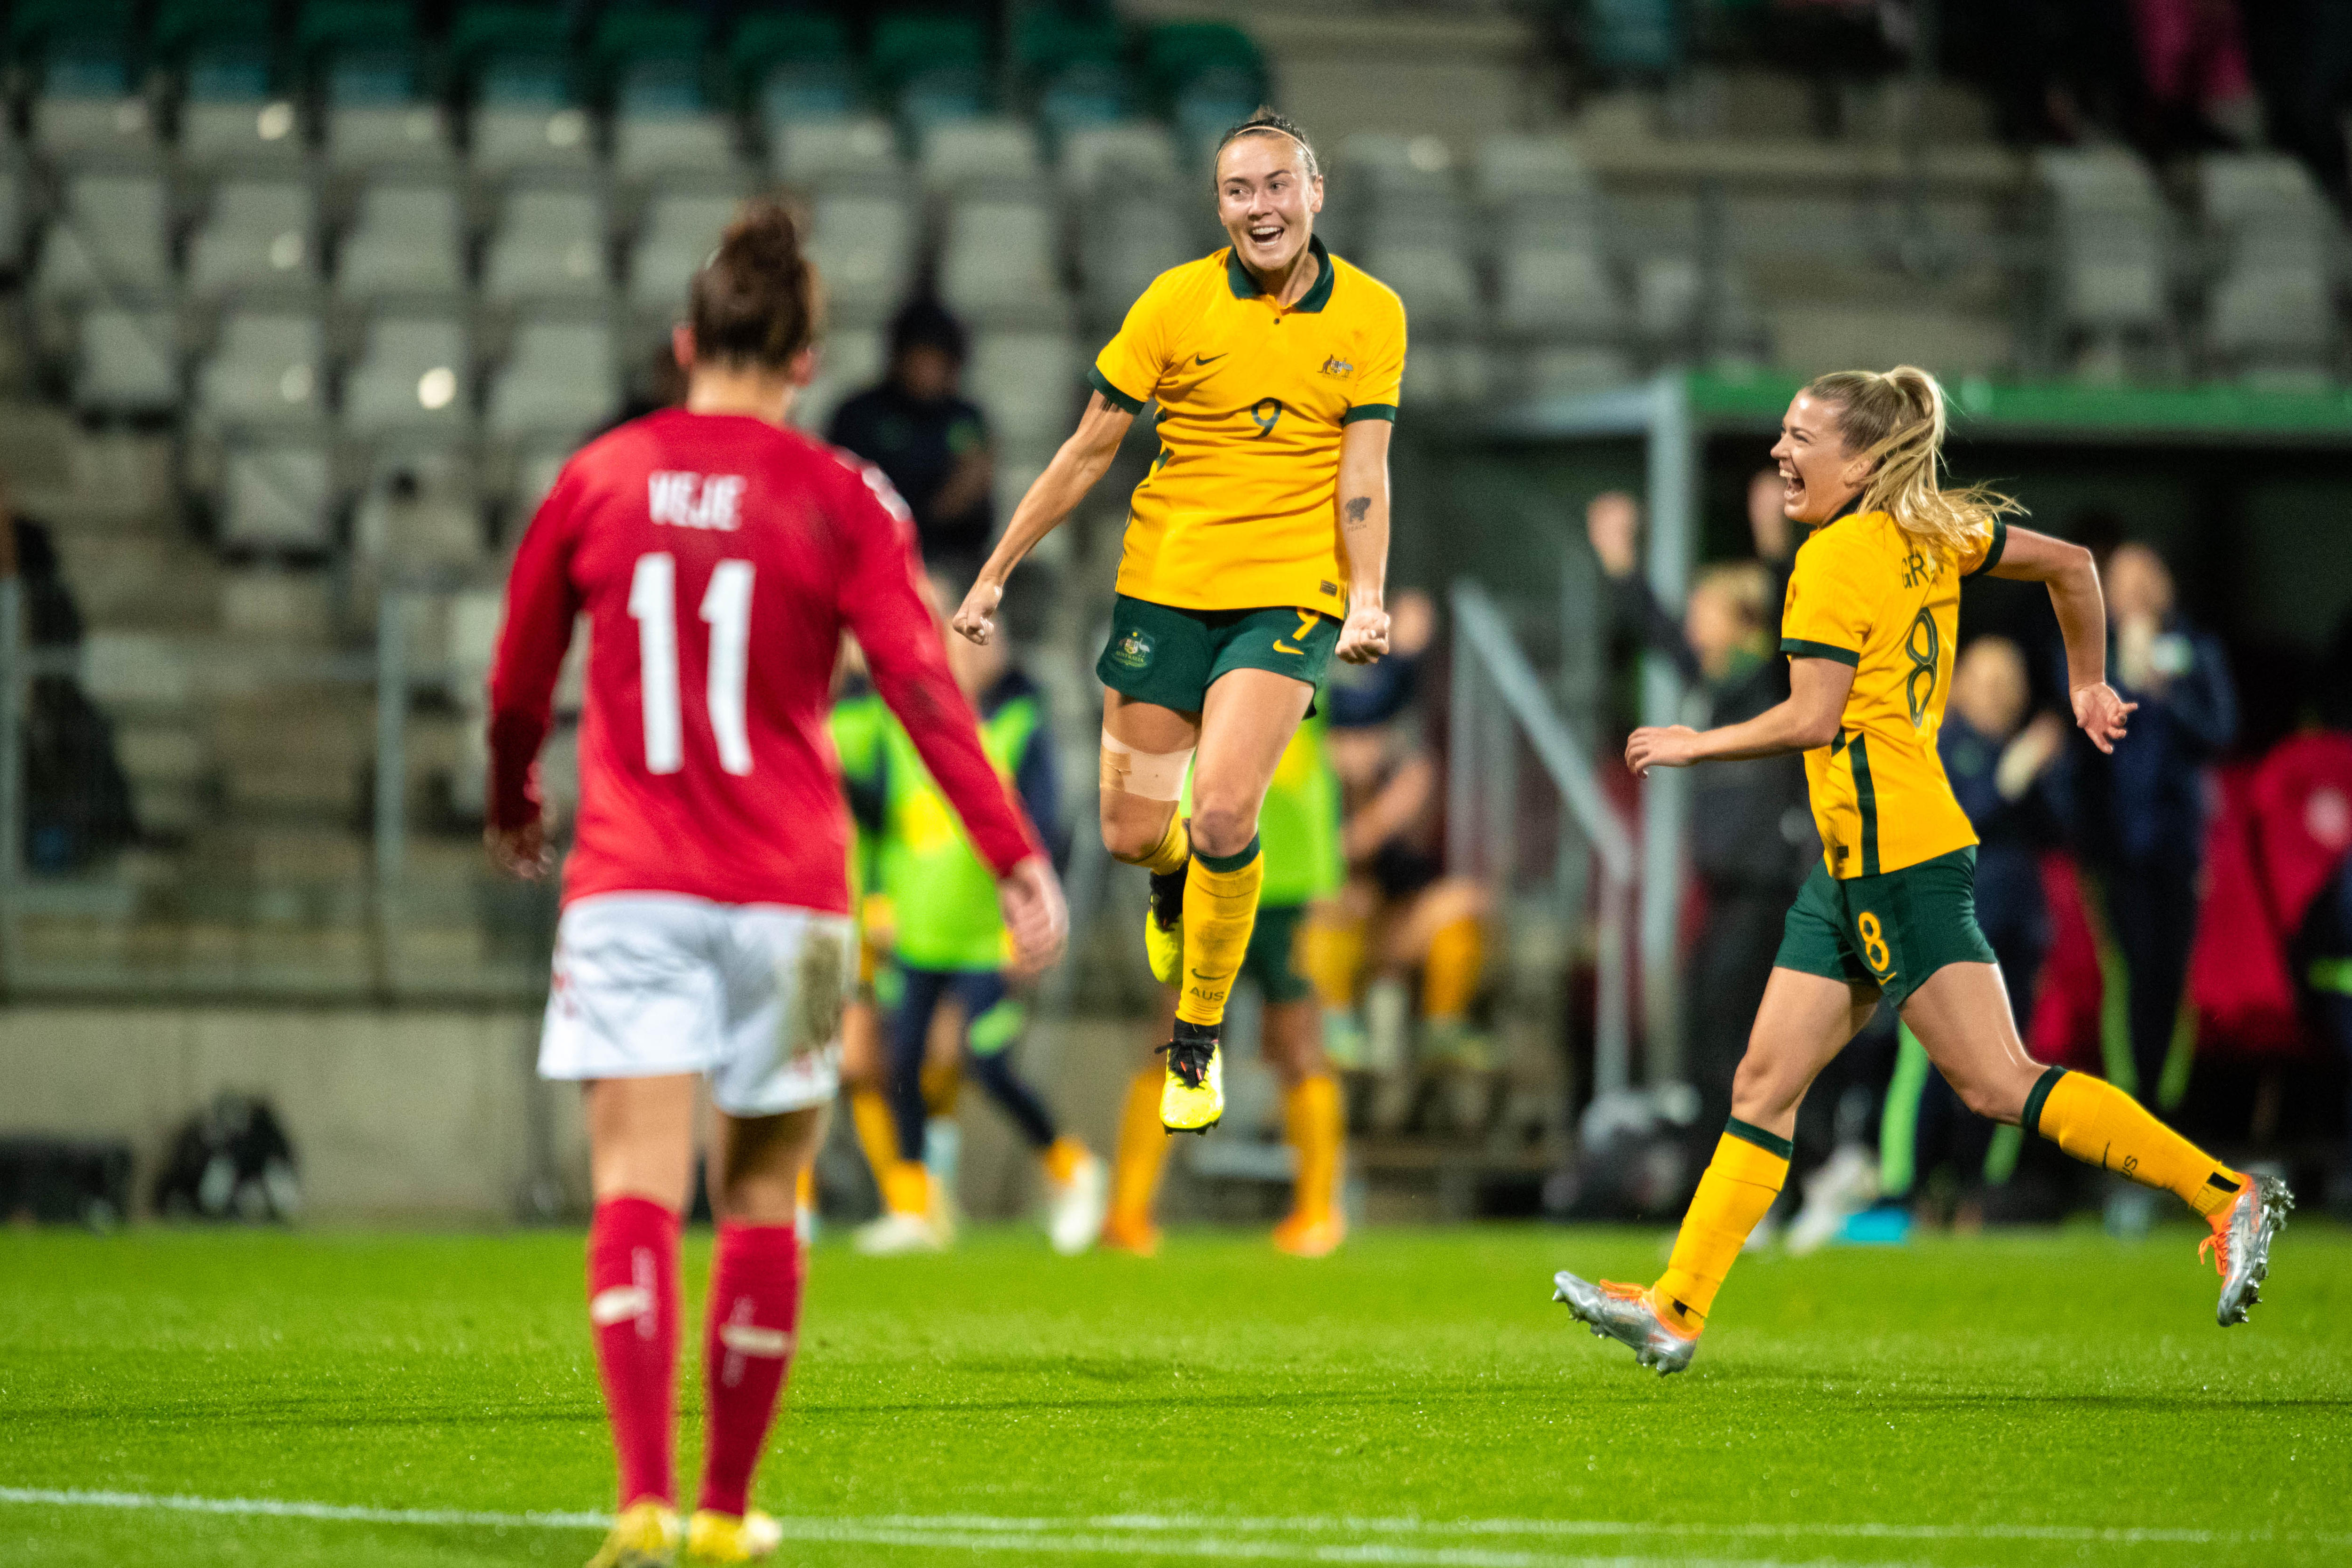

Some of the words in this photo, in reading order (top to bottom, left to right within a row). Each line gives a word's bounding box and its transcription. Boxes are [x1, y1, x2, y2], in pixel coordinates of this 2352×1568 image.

[1251, 397, 1282, 439] 9
[649, 470, 747, 531] VEJE
[1901, 554, 1944, 589] GR
[628, 551, 756, 776] 11
[1906, 607, 1939, 728] 8
[1859, 911, 1889, 971] 8
[1190, 987, 1224, 1001] AUS
